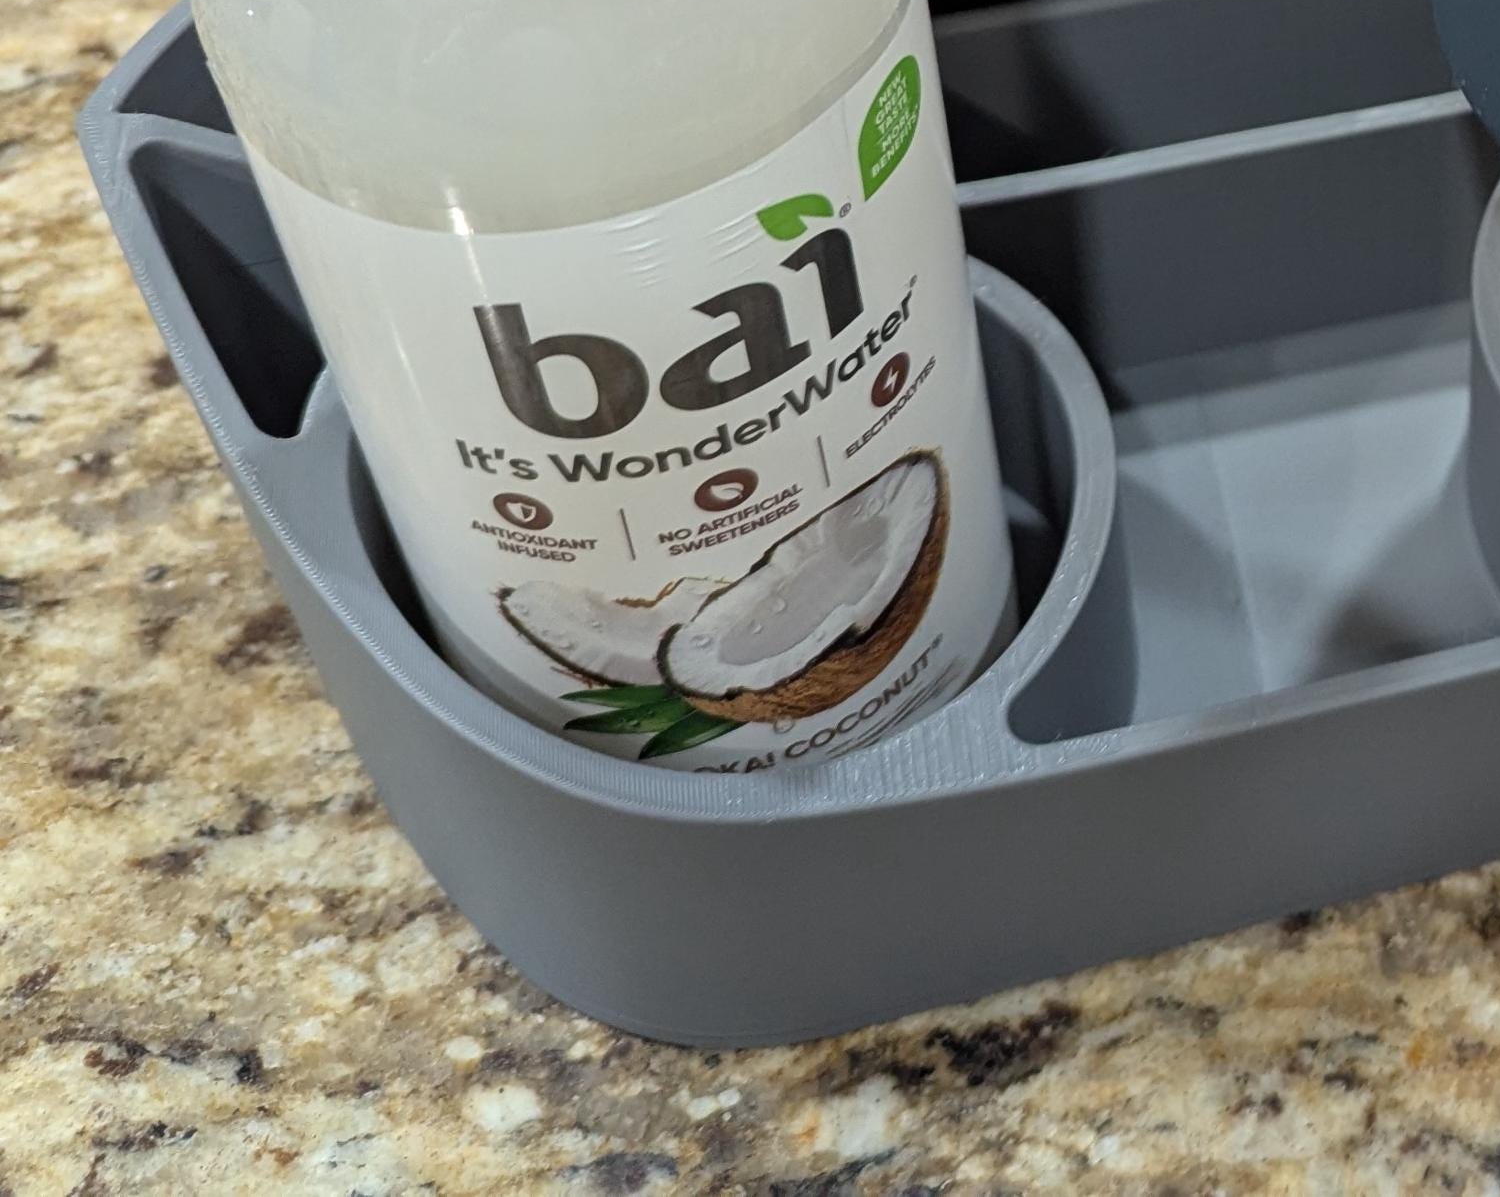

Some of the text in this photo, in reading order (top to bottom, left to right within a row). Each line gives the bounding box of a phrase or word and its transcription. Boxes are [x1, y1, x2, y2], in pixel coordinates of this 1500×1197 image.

[472, 193, 865, 440] bai
[455, 287, 914, 484] It's WonderWater
[844, 354, 938, 460] ELECTROLYTES
[470, 519, 598, 551] ANTIOXIDANT
[497, 539, 577, 563] INFUSED
[657, 483, 804, 544] NO ARTIFICIAL
[667, 498, 801, 557] SWEETENERS
[784, 647, 931, 759] COCONUT
